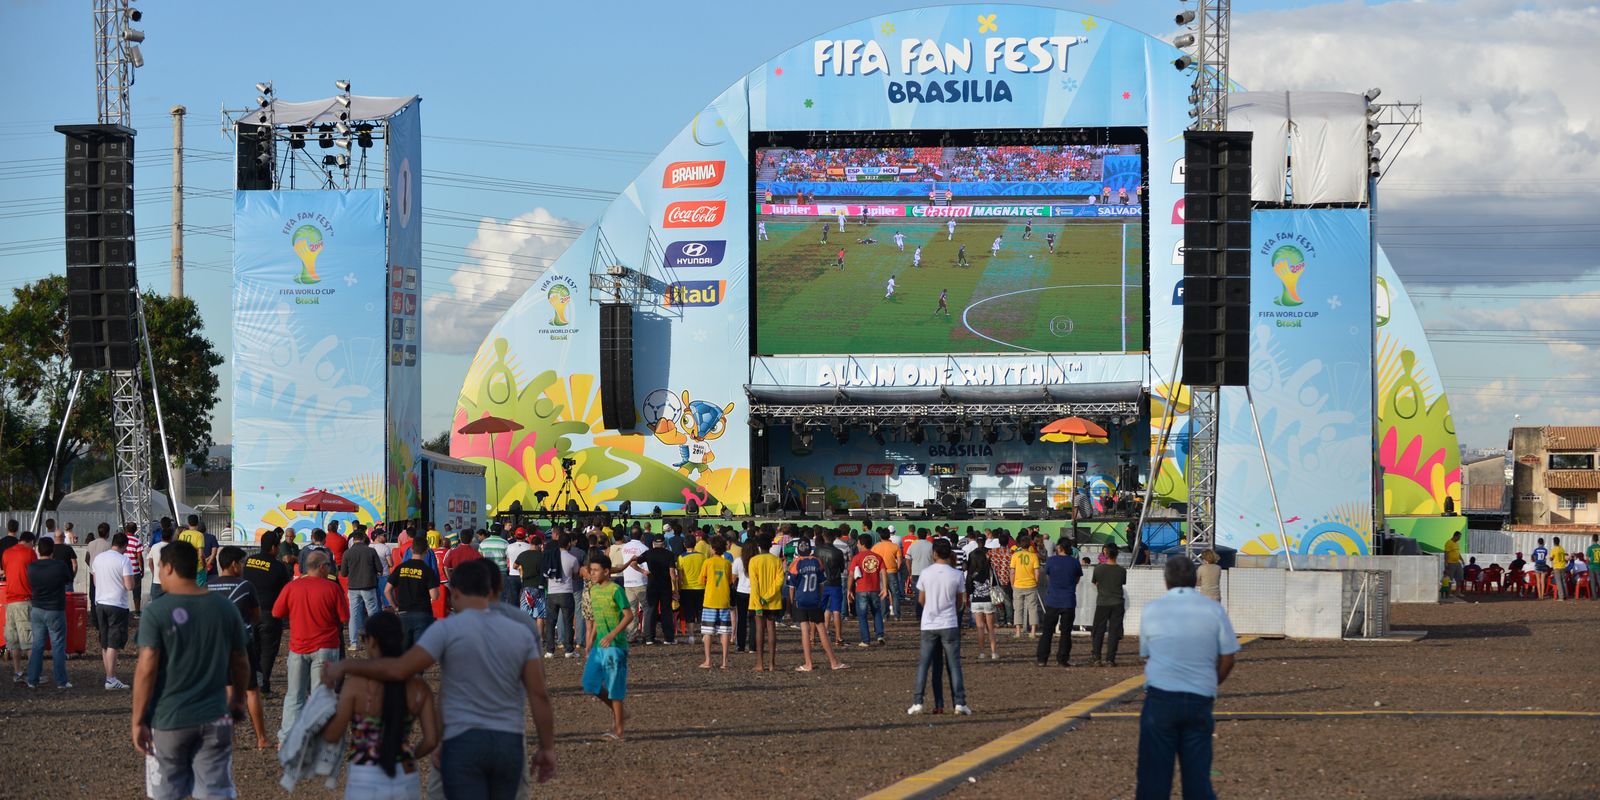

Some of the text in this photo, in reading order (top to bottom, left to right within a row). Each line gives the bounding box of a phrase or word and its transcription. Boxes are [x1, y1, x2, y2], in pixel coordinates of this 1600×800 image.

[814, 39, 890, 77] FIFA
[901, 38, 973, 76] FAN
[887, 79, 1013, 104] BRASILIA
[671, 163, 717, 185] BRAHMA
[668, 205, 719, 224] Coca-Cola
[858, 205, 899, 217] Jpiler
[924, 205, 1043, 218] Castrol MAGNATEC
[282, 217, 297, 236] FIFA
[297, 211, 315, 222] FAN
[1260, 238, 1277, 256] FIFA
[1276, 231, 1295, 242] FAN
[676, 257, 713, 266] HYUNDAI
[279, 288, 336, 296] FIFA WORLD CUP
[540, 279, 552, 292] FIFA
[550, 274, 564, 282] FAN
[1275, 318, 1302, 328] Brasil
[817, 363, 866, 387] ALL
[870, 363, 896, 387] IN
[902, 363, 954, 386] ONE
[246, 557, 271, 568] SEOPS
[1018, 552, 1030, 566] 10
[1537, 552, 1545, 560] 10
[400, 566, 423, 576] SEOPS
[714, 570, 724, 588] 7
[802, 573, 818, 593] 10
